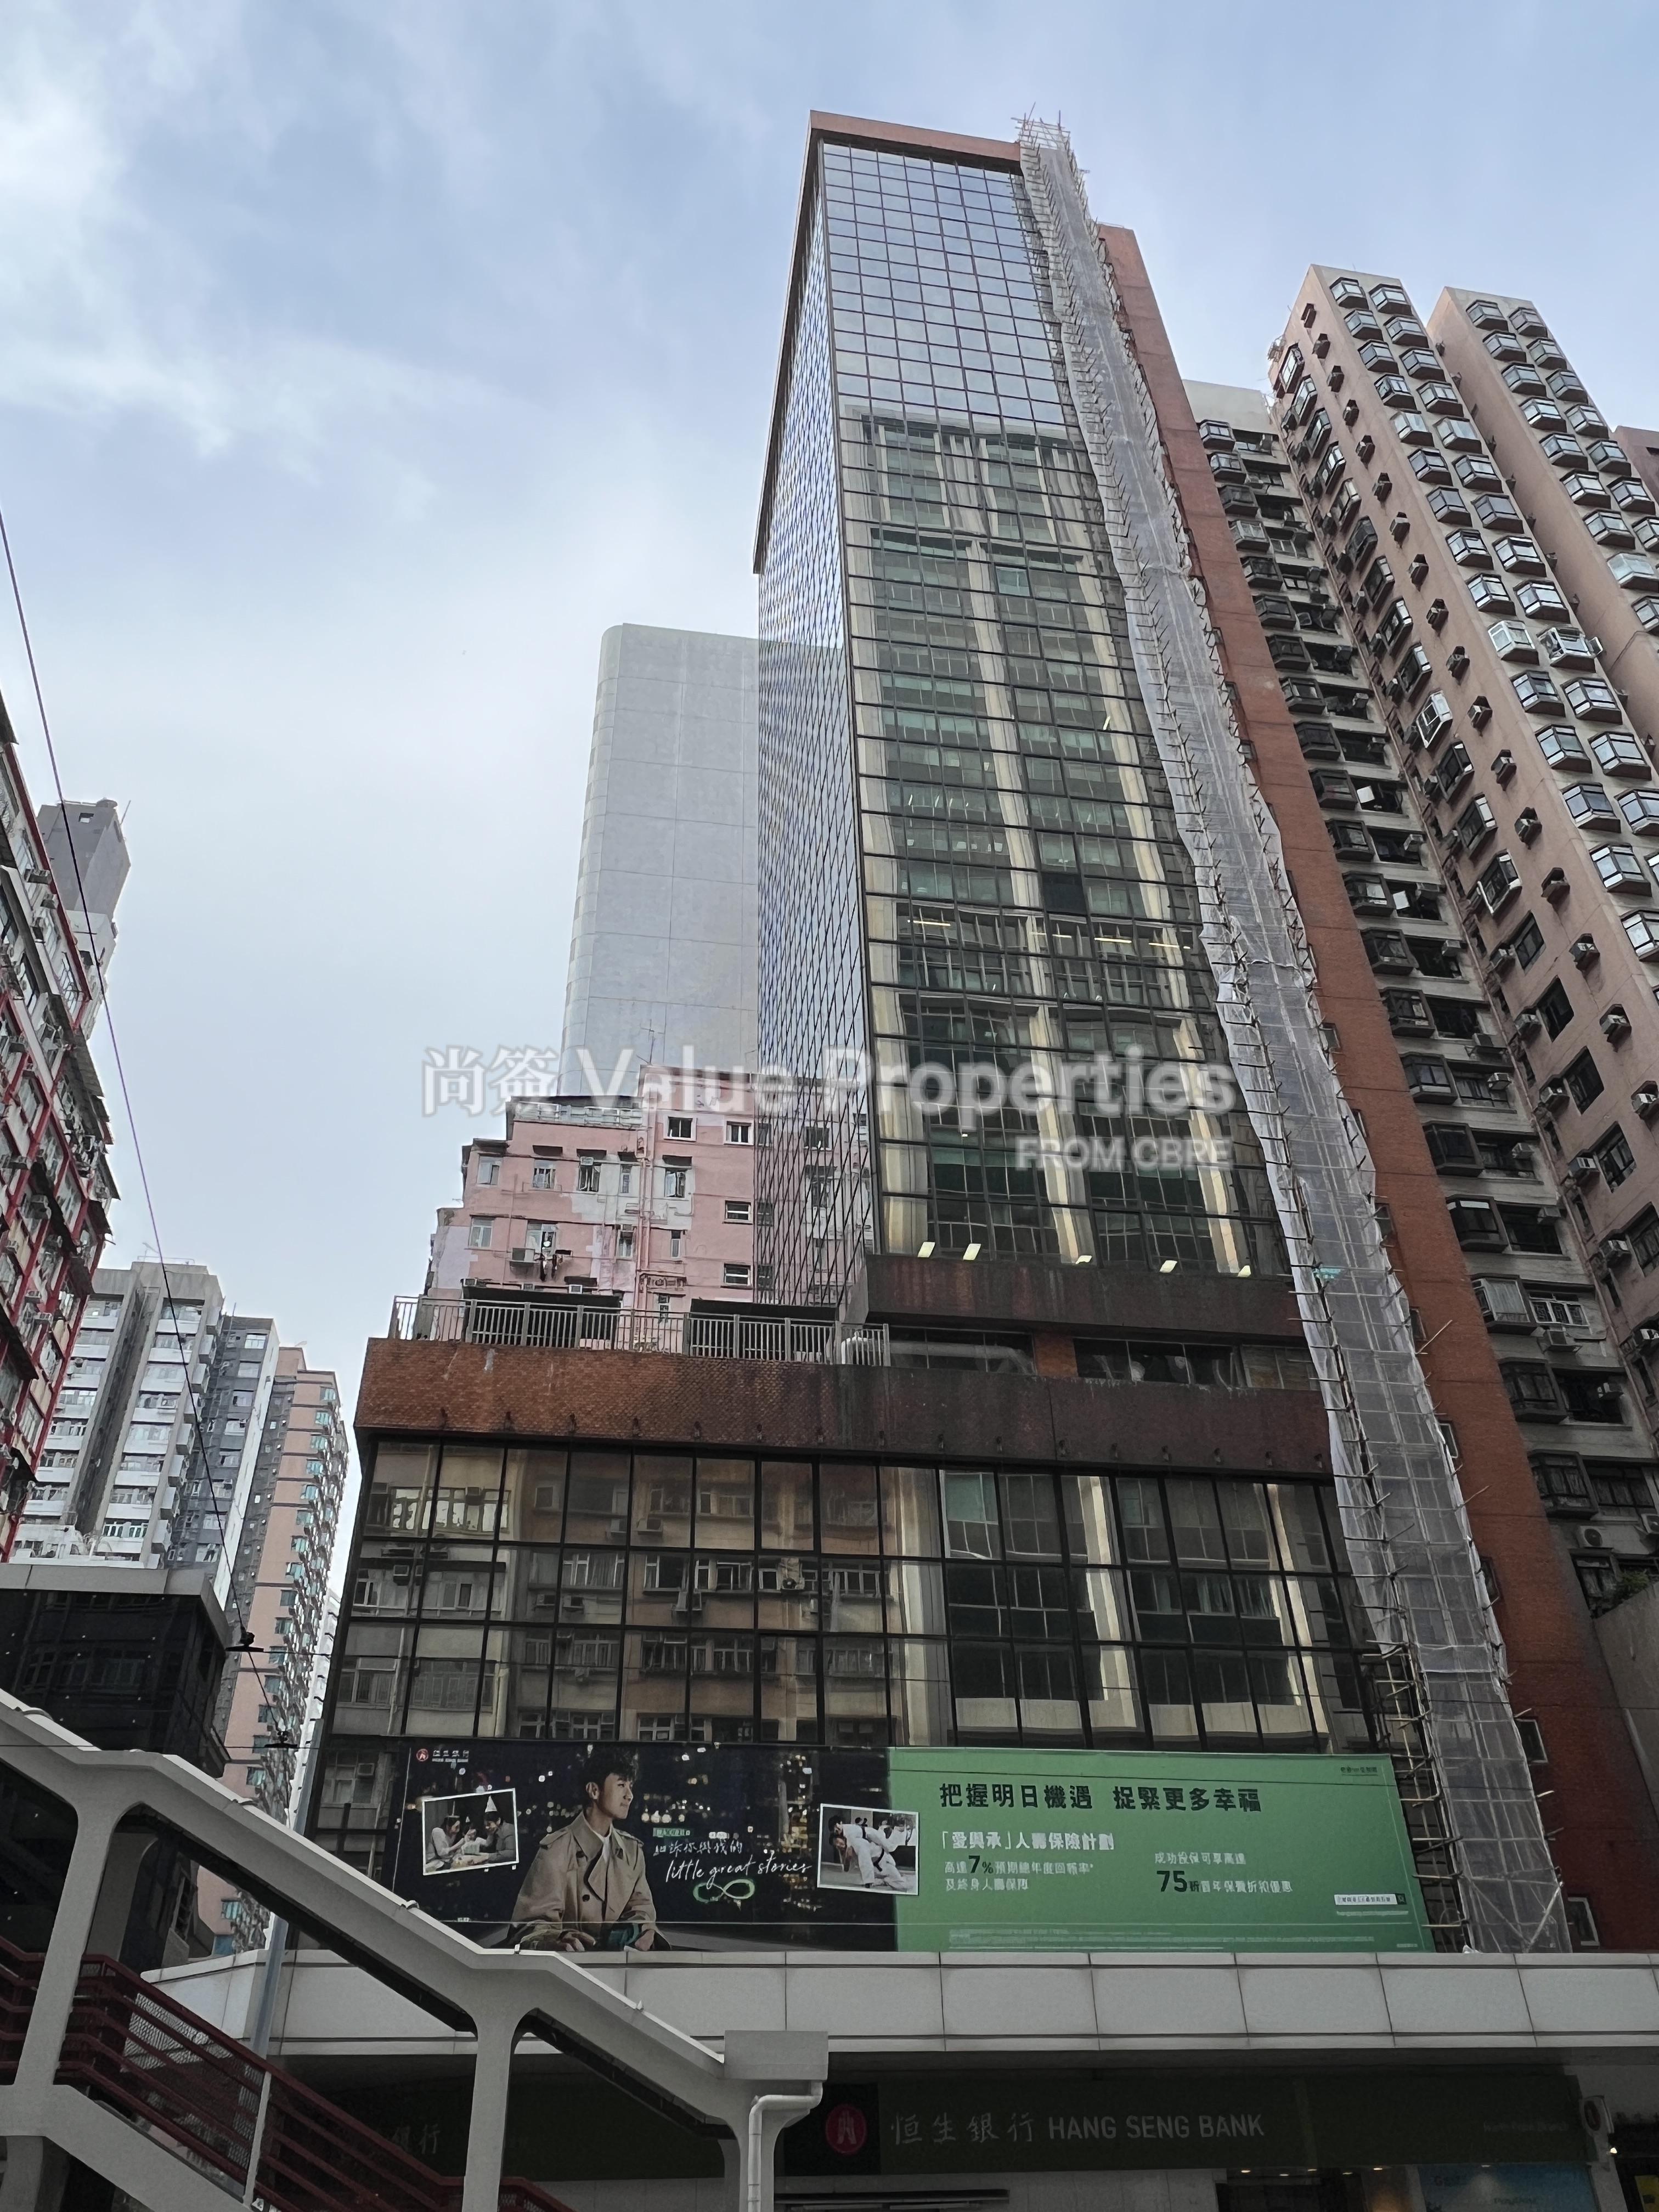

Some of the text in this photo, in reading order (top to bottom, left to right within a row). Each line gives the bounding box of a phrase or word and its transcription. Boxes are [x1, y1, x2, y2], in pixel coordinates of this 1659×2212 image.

[939, 1782, 1261, 1812] 把握明日機遇 捉緊更多幸福
[665, 1859, 704, 1882] little
[706, 1854, 756, 1889] great
[890, 2112, 1034, 2146] 恒生銀行
[1049, 2113, 1266, 2140] HANG SENG BANK
